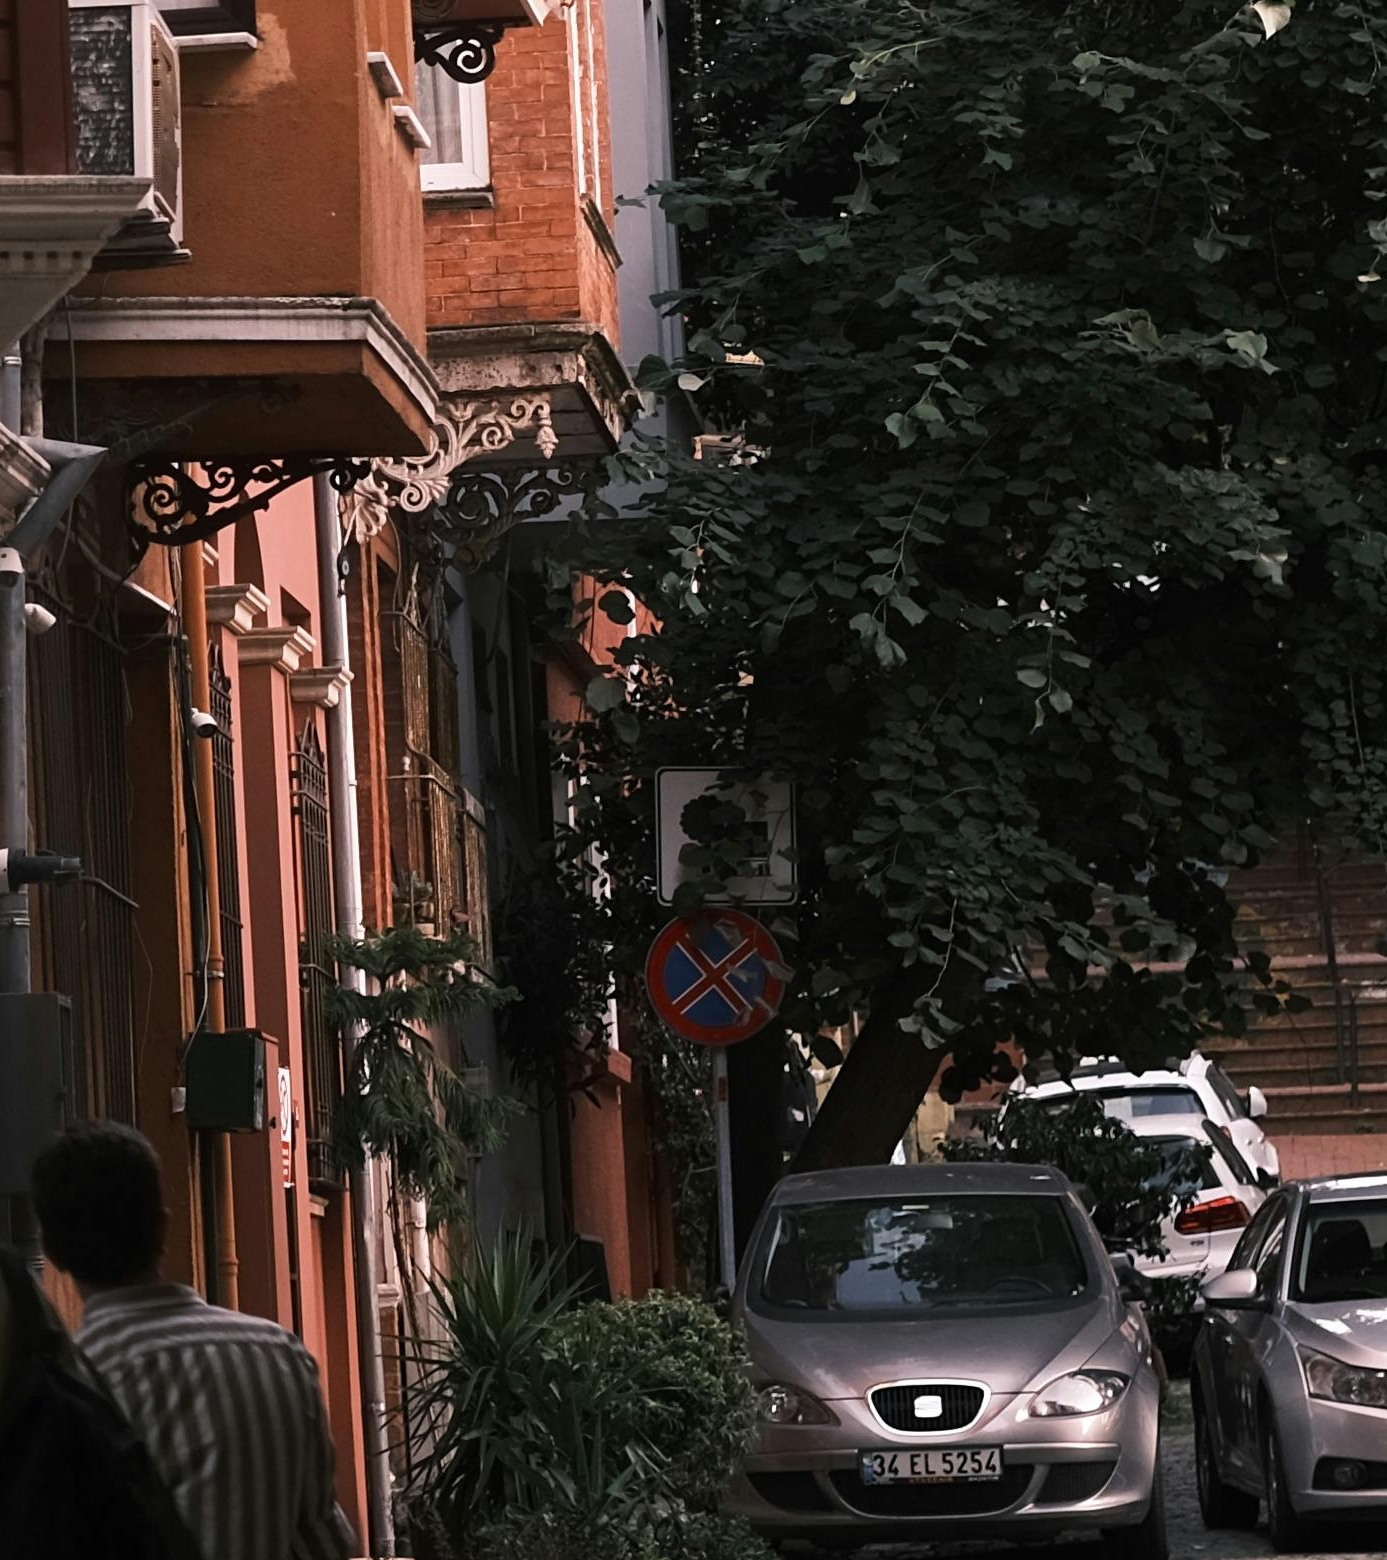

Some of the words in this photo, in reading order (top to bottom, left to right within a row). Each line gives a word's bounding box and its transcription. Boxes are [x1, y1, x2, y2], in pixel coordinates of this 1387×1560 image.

[873, 1453, 899, 1476] 34
[910, 1453, 936, 1475] EL
[942, 1451, 996, 1474] 5254
